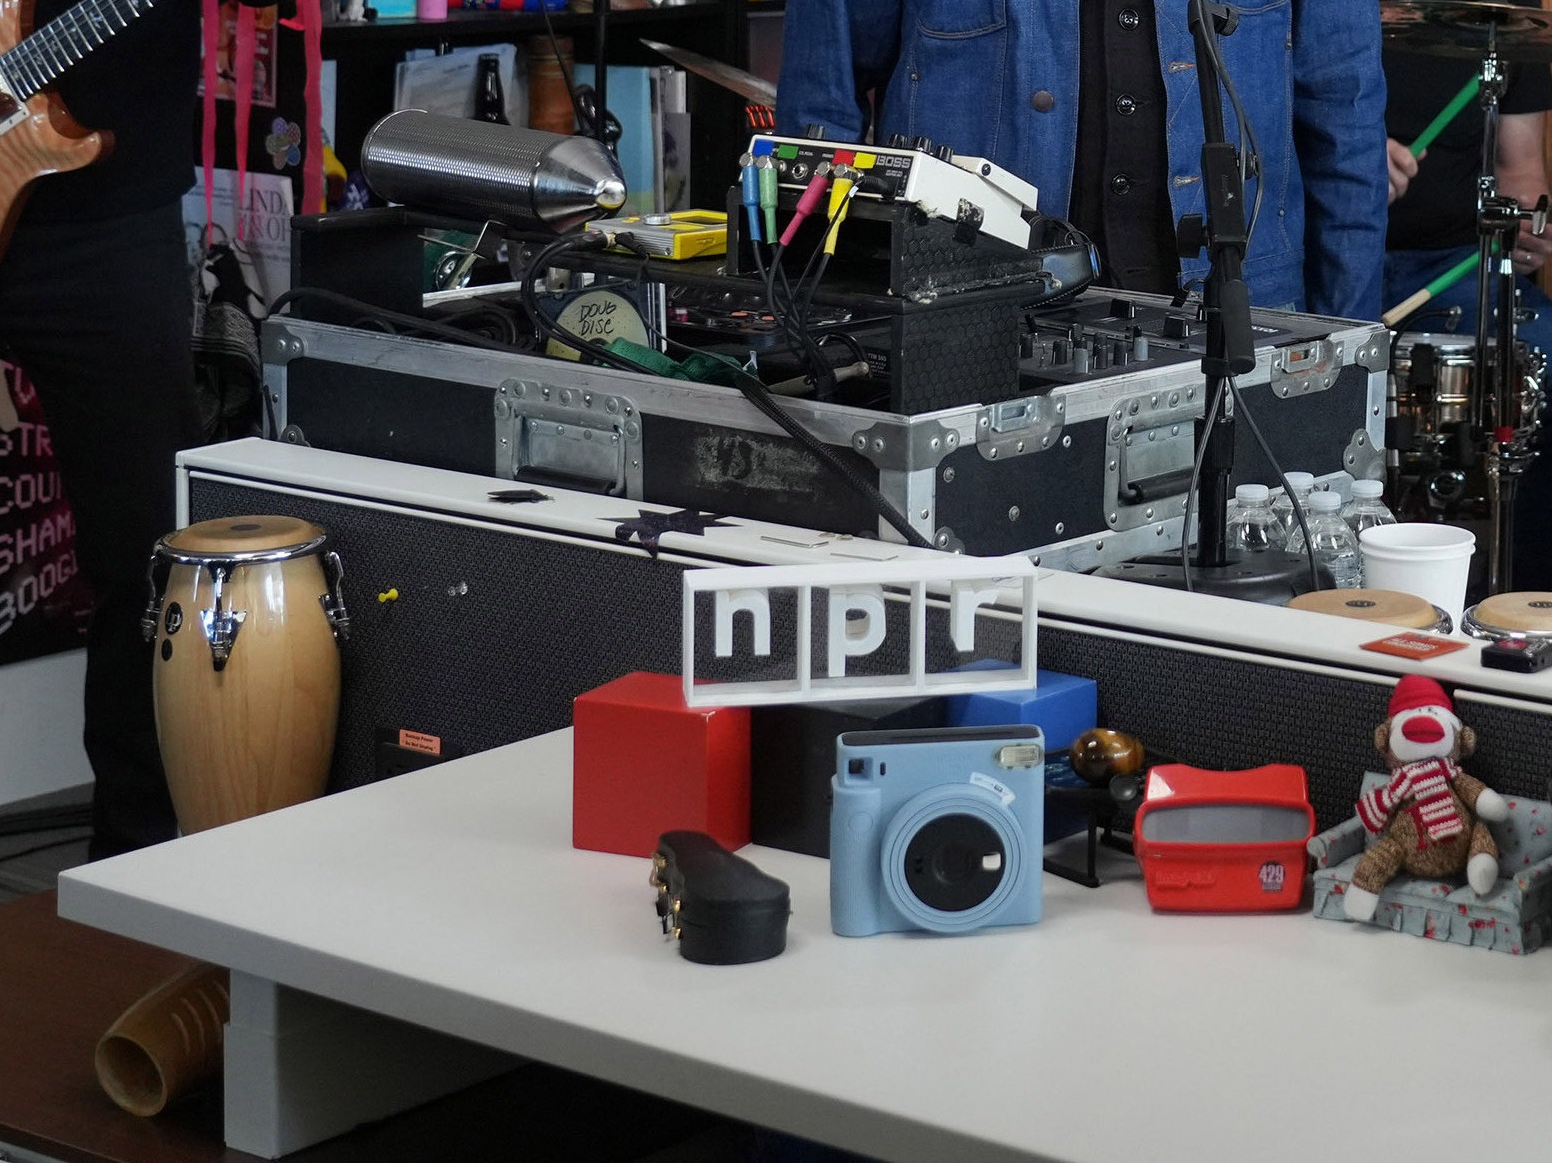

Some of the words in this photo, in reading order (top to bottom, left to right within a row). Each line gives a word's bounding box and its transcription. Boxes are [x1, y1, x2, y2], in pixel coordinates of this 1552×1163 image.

[876, 154, 911, 169] BOSS
[577, 301, 617, 323] DOUG
[579, 317, 615, 336] DISC
[713, 579, 999, 678] npr
[1259, 863, 1285, 885] 429
